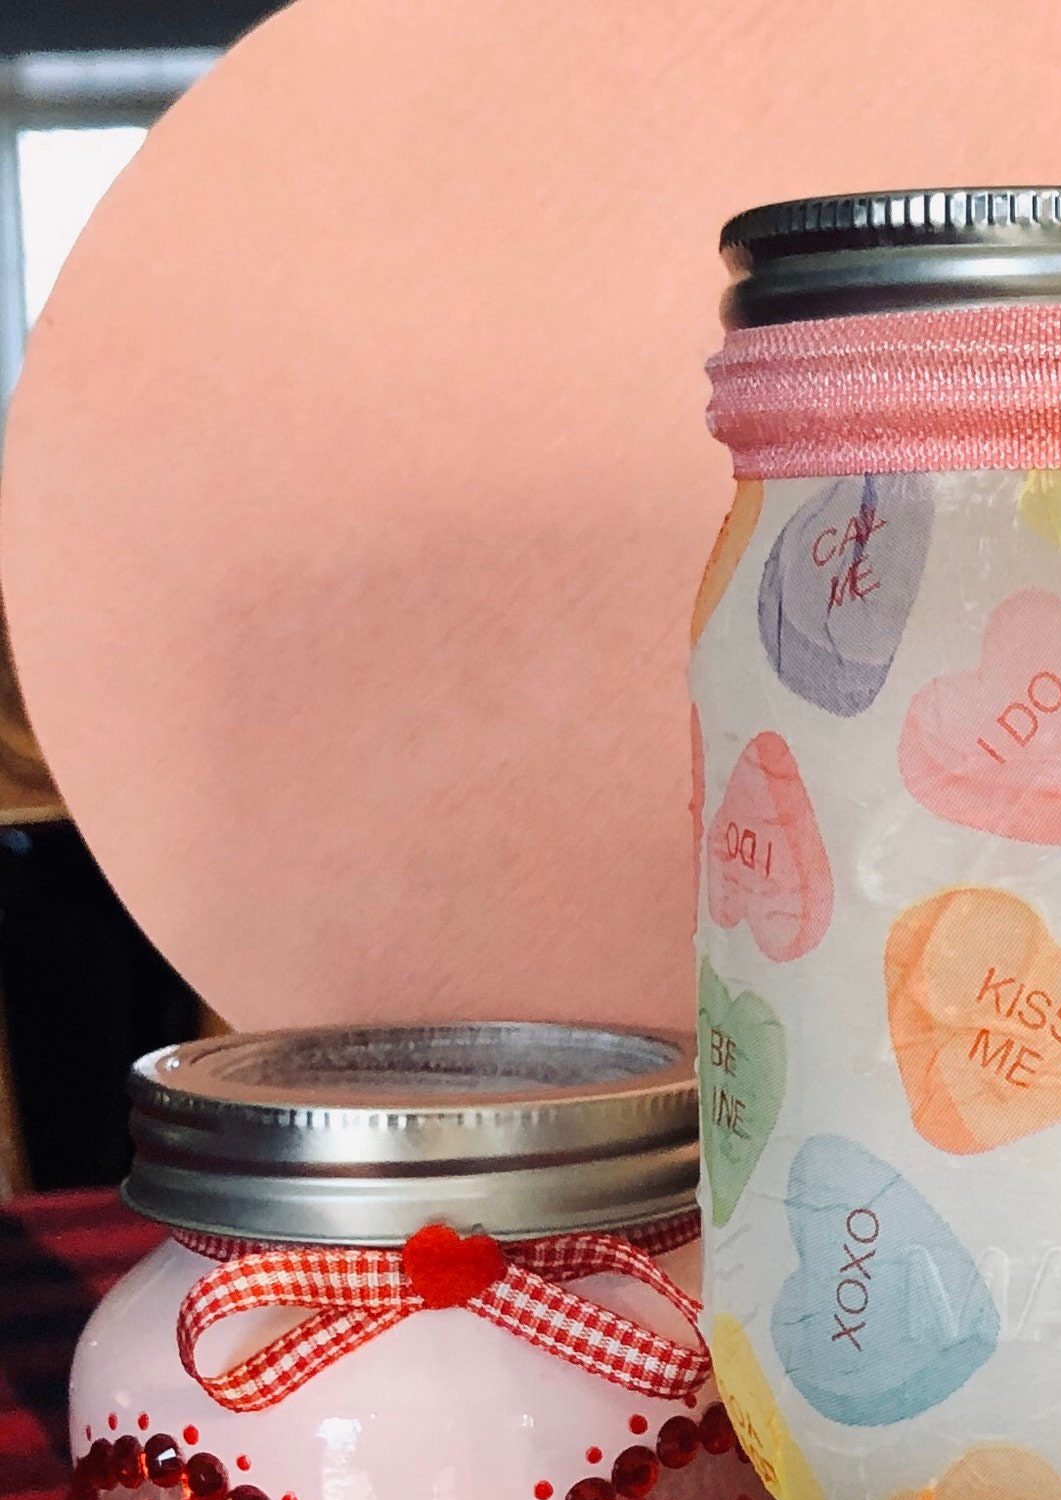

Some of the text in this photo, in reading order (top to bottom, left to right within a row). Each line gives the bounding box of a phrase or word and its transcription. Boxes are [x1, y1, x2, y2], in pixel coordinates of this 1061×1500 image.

[977, 737, 1006, 765] I
[726, 821, 757, 870] DO
[711, 1029, 737, 1078] BE
[968, 1028, 1043, 1088] ME
[711, 1086, 747, 1139] INE
[831, 1208, 880, 1352] XOXO
